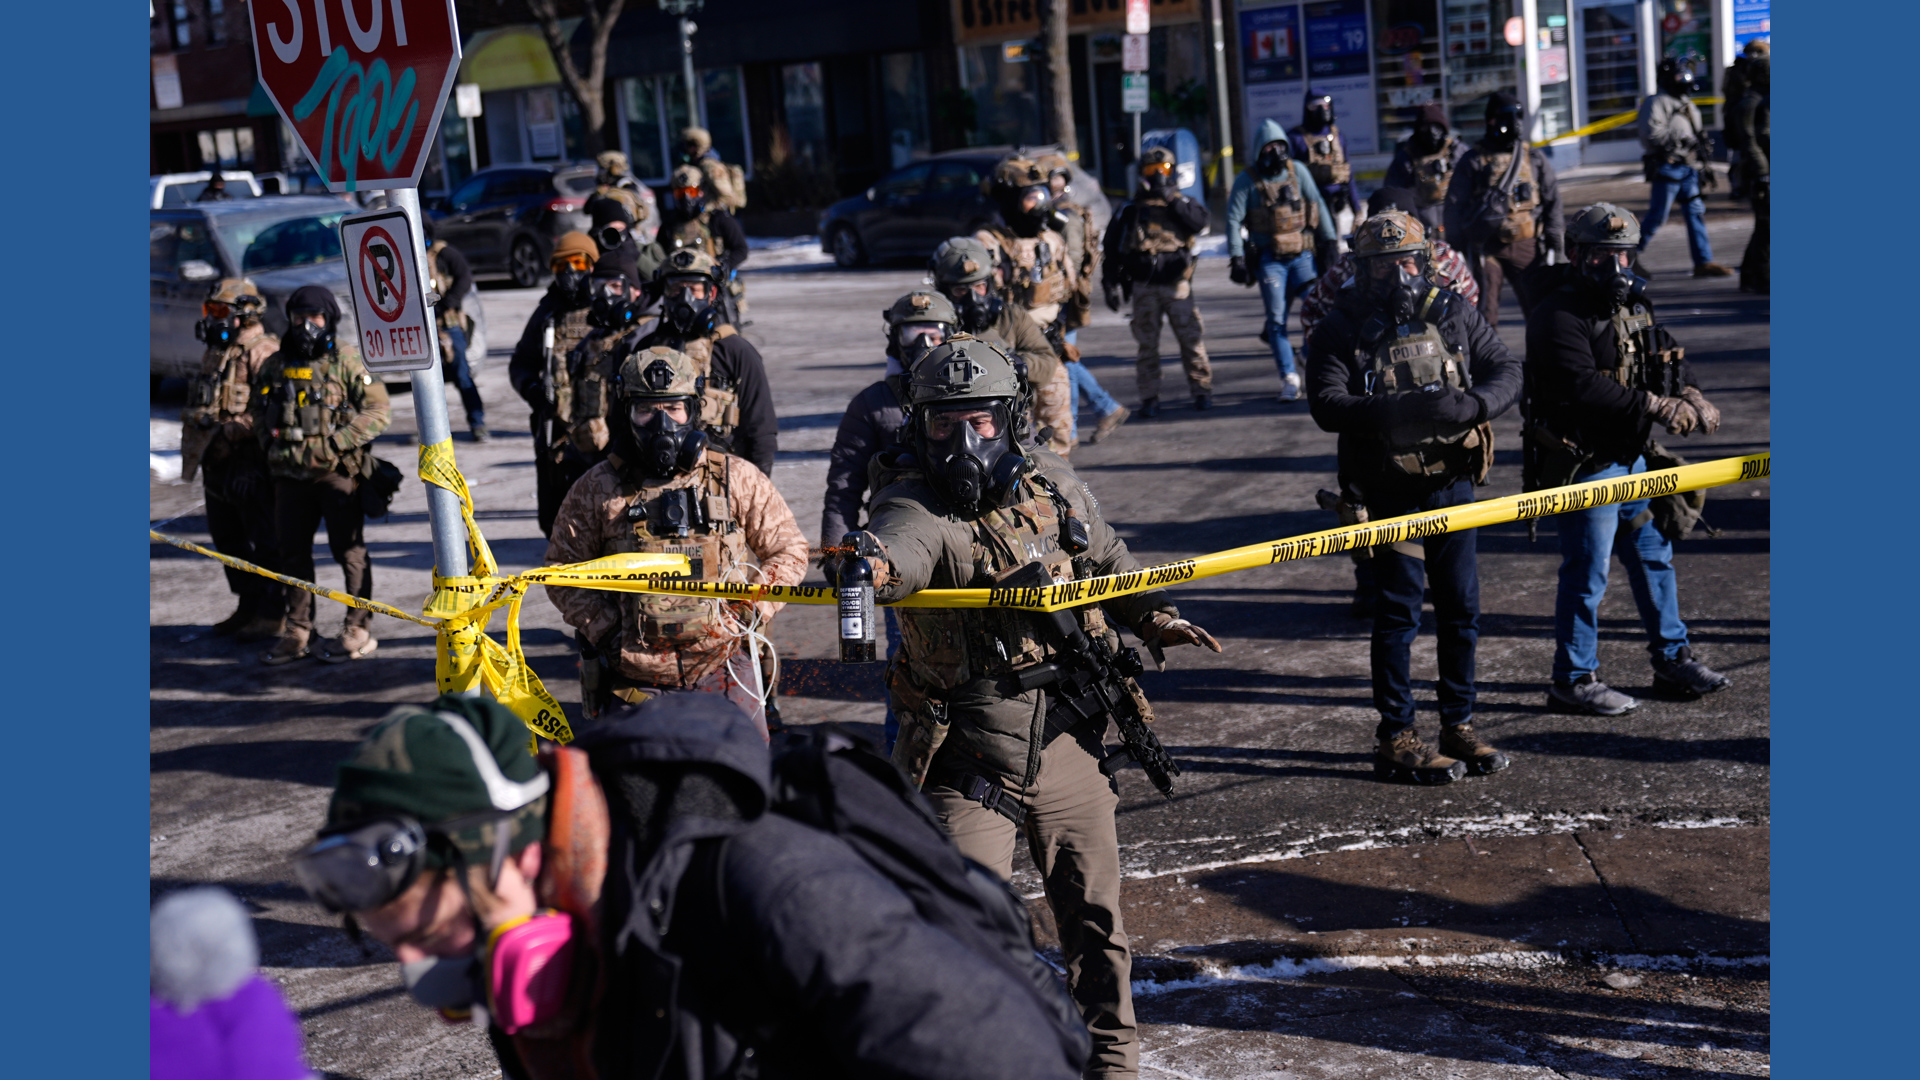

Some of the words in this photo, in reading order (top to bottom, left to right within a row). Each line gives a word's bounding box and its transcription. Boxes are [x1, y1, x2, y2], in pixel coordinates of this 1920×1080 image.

[366, 329, 384, 358] 30
[390, 326, 423, 356] FEET
[1392, 342, 1434, 360] POLICE
[1516, 494, 1558, 520] POLICE
[1560, 488, 1589, 511] LINE
[1591, 484, 1608, 505] DO
[1609, 480, 1637, 503] NOT
[1637, 473, 1679, 498] CROSS
[1271, 537, 1317, 564] POLICE
[1320, 531, 1350, 555] LINE
[1352, 527, 1372, 549] DO
[1375, 522, 1402, 545] NOT
[1405, 513, 1449, 540] CROSS
[648, 580, 708, 593] POLICE
[714, 583, 754, 595] LINE
[789, 585, 827, 598] NOT
[988, 587, 1047, 607] POLICE
[1050, 581, 1085, 606] LINE
[1088, 578, 1110, 597] DO
[1111, 567, 1145, 593] NOT
[1146, 559, 1197, 586] CROSS
